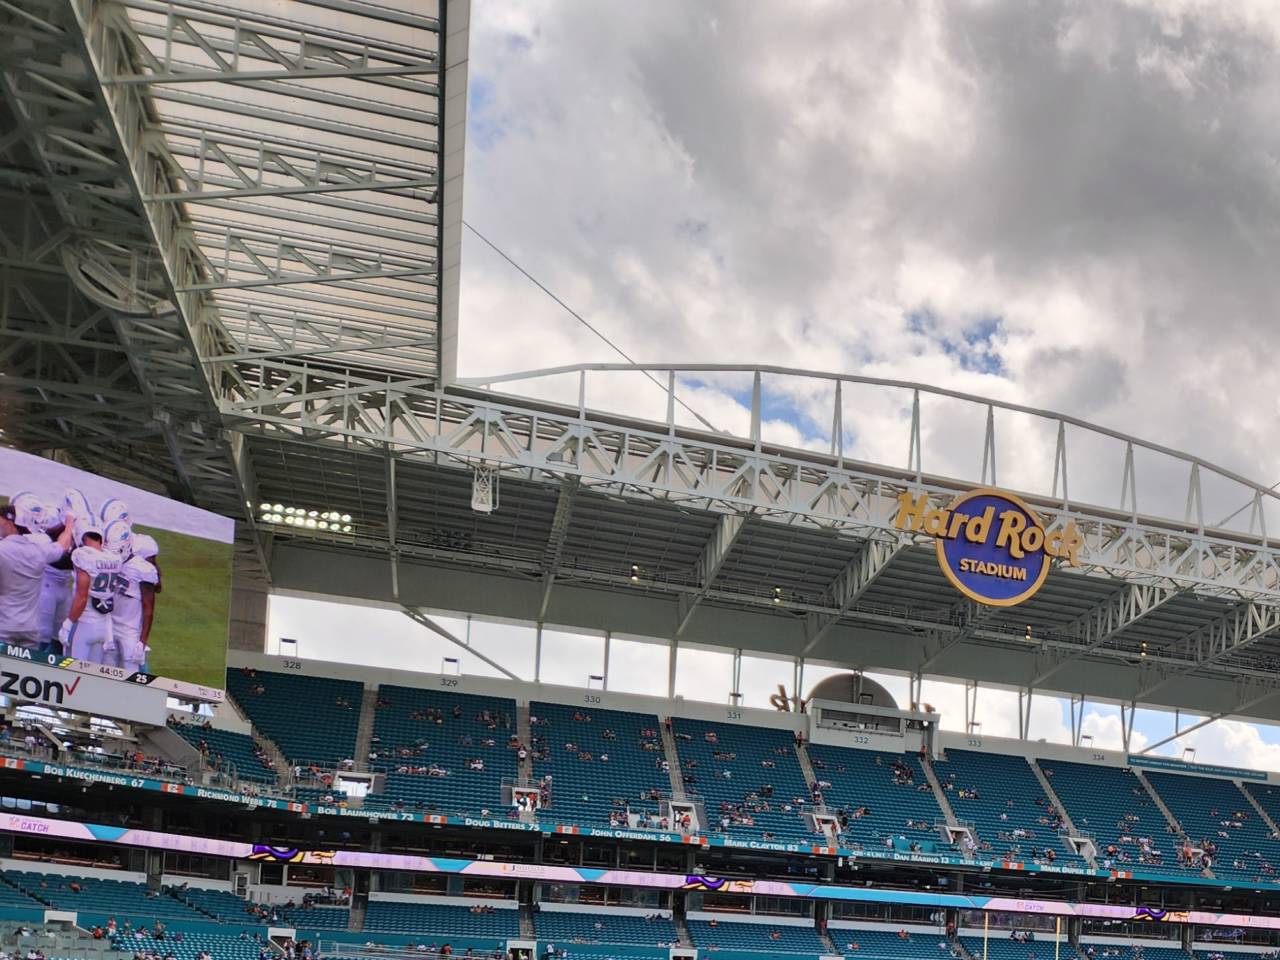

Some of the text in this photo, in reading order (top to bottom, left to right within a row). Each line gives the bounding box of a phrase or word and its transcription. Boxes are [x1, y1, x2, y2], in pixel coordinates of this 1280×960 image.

[895, 489, 1084, 568] Hard Rock
[959, 558, 1027, 581] STADIUM
[7, 645, 56, 665] MIA 0
[283, 660, 301, 670] 328
[99, 666, 124, 678] 44:05
[135, 672, 148, 684] 25
[0, 671, 64, 704] zon
[440, 678, 458, 688] 329
[584, 694, 600, 704] 330
[727, 711, 741, 720] 331
[853, 735, 869, 744] 332
[968, 739, 982, 747] 333
[44, 765, 64, 776] BOB
[131, 778, 144, 788] 67
[318, 806, 337, 816] BOB
[401, 812, 414, 821] 73
[20, 821, 49, 833] CATCH
[465, 818, 490, 828] DOUG
[590, 828, 613, 838] JOHN
[660, 833, 671, 842] 56
[724, 838, 799, 852] MARK CLAYTON 83
[894, 853, 909, 861] DAN
[911, 854, 940, 863] MARINO
